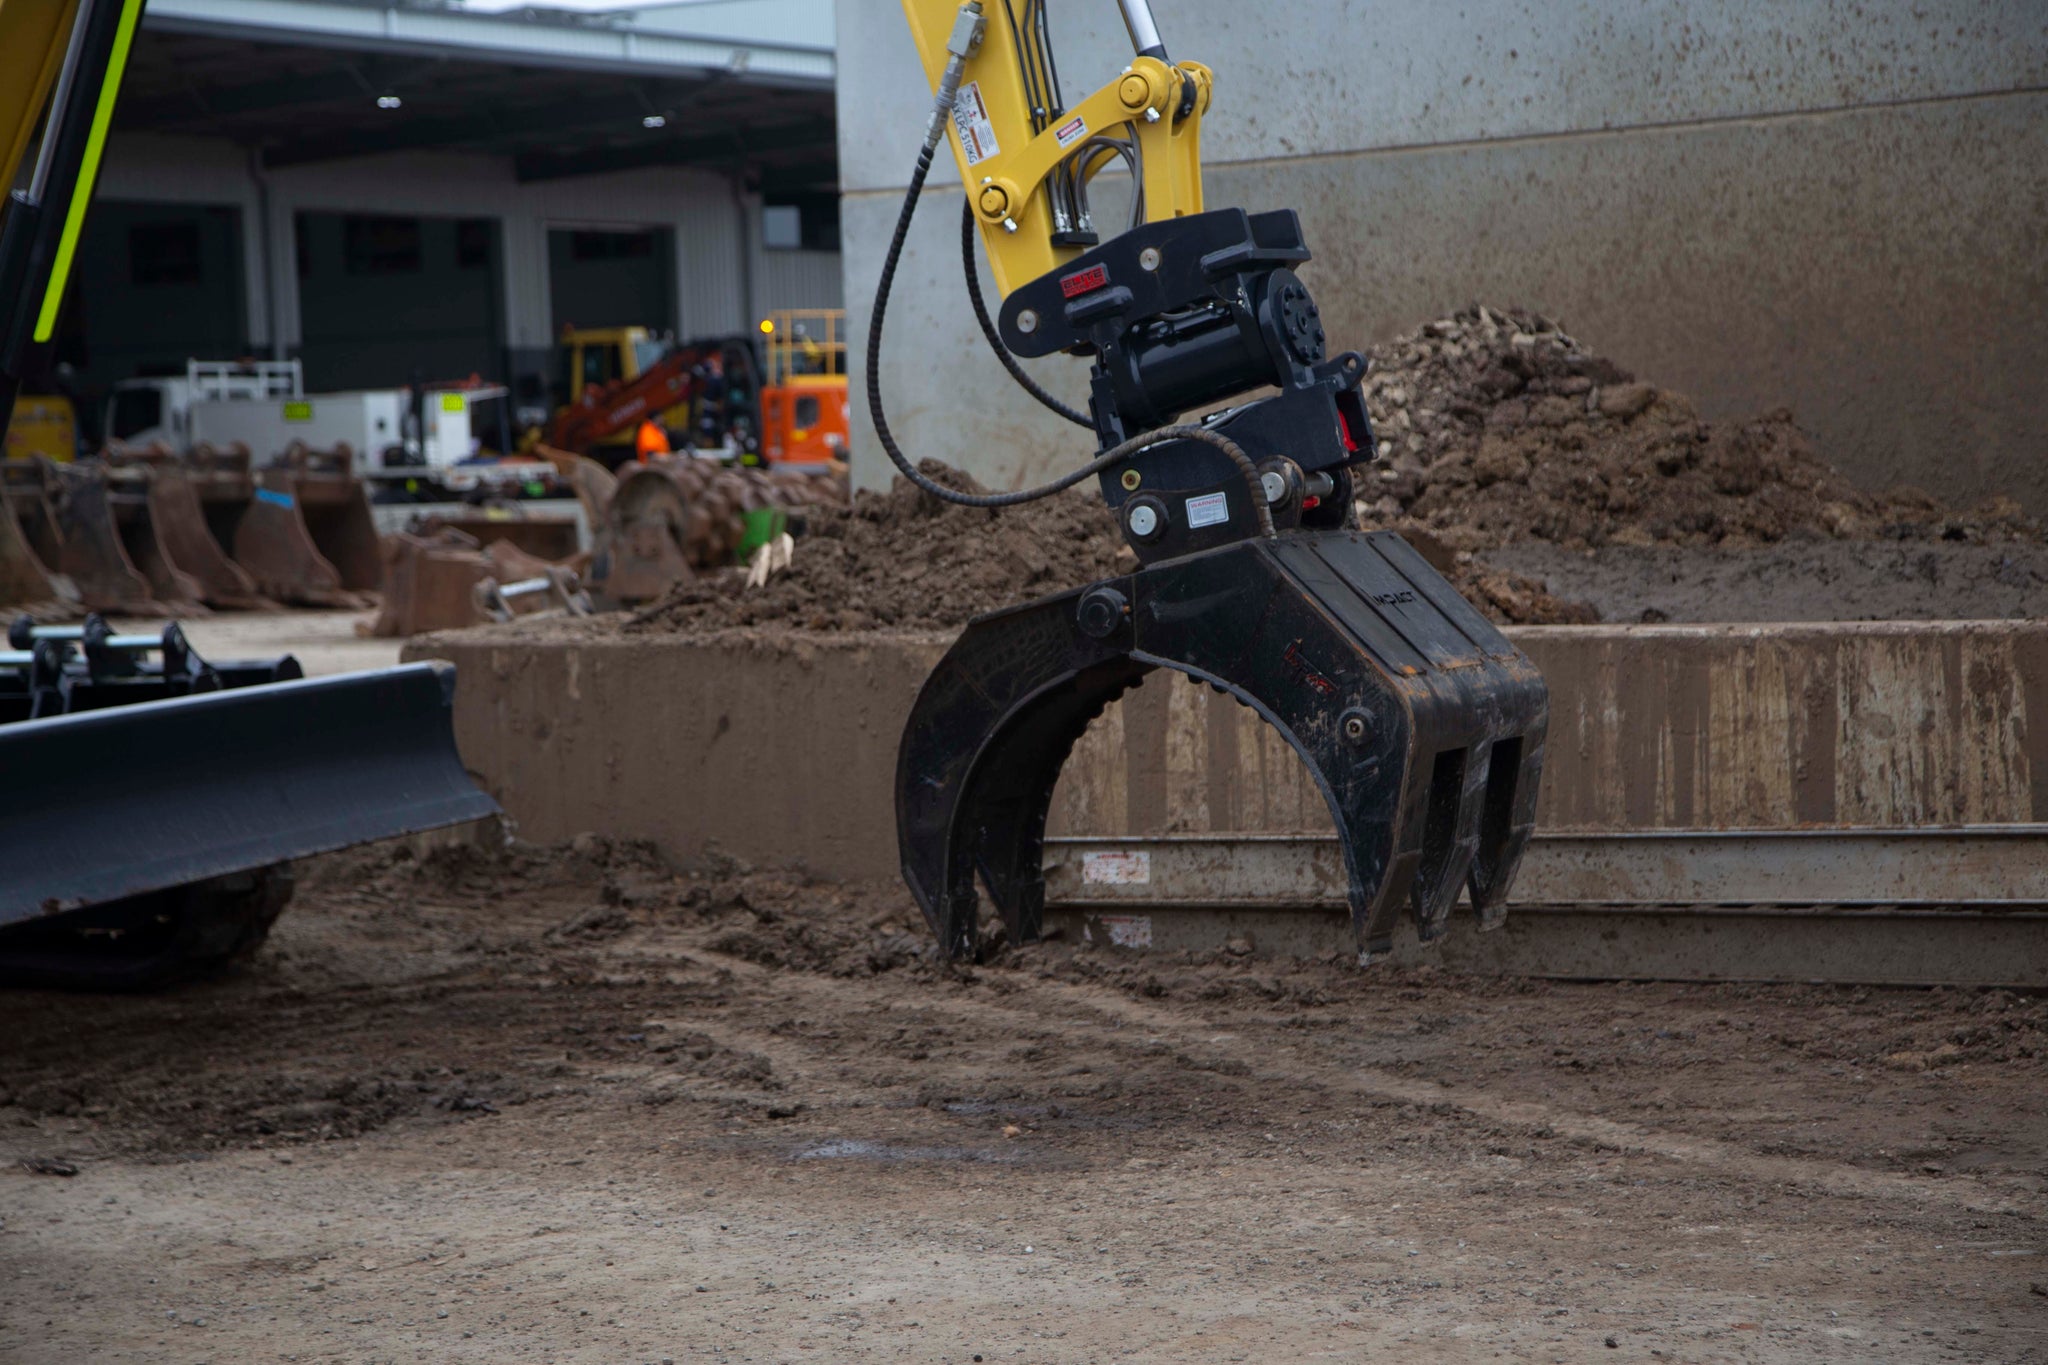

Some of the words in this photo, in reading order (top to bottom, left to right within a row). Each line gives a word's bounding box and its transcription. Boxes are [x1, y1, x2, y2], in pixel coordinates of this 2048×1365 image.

[955, 115, 968, 133] LPC
[960, 132, 978, 164] 510KG
[1061, 266, 1104, 289] ELITE
